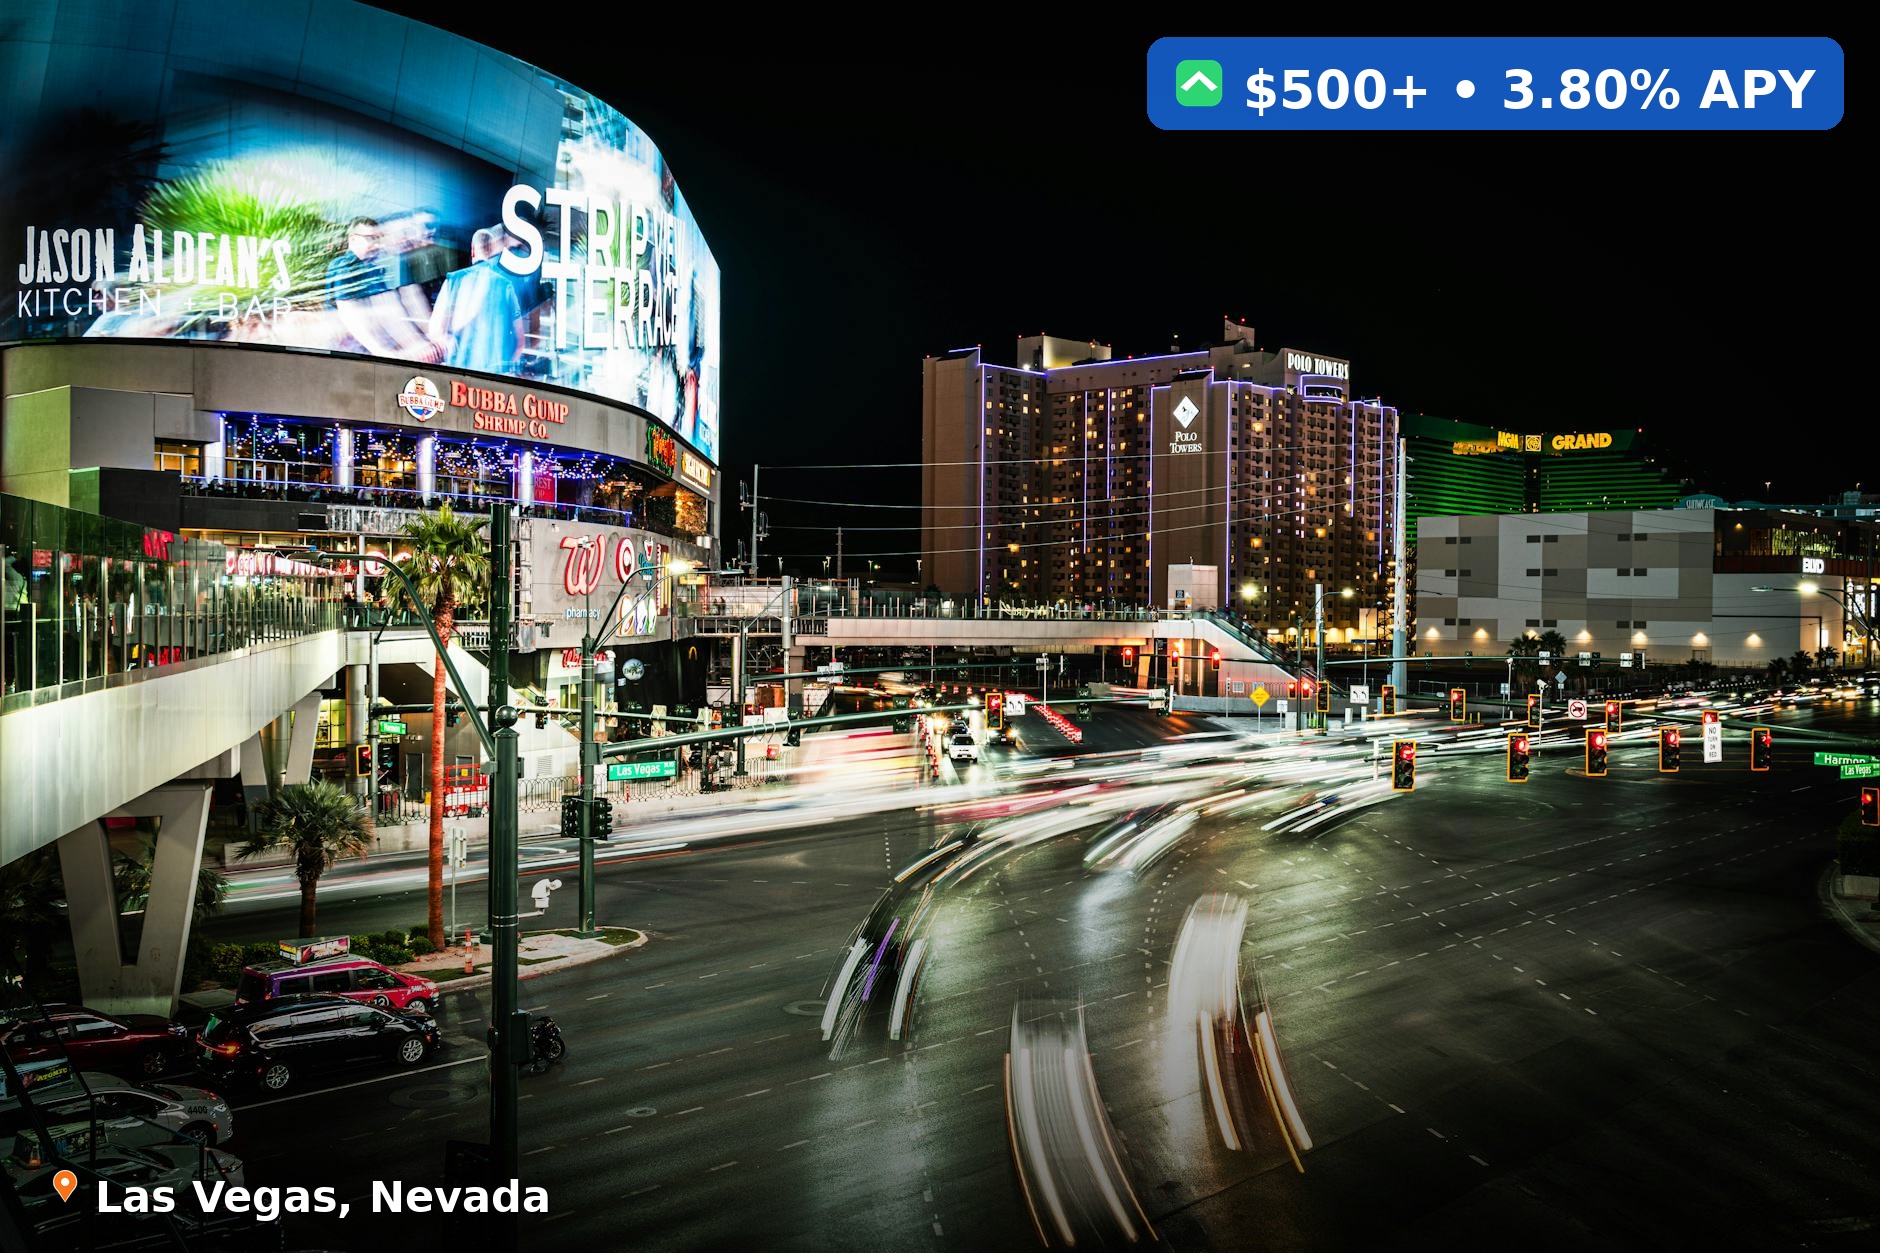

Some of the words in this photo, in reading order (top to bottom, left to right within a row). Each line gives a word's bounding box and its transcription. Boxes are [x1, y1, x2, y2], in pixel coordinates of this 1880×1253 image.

[500, 184, 649, 275] STRIP
[19, 225, 115, 285] JASON
[129, 223, 292, 292] ALDEAN'S
[18, 287, 161, 318] KITCHEN
[541, 263, 677, 350] TERRACE
[1287, 352, 1312, 373] POLO
[1314, 358, 1349, 380] TOWERS
[450, 380, 518, 416] BUBBA
[523, 393, 569, 424] GUMP
[474, 411, 527, 436] SHRIMP
[529, 420, 550, 439] CO.
[1175, 431, 1198, 442] POLO
[1170, 442, 1203, 454] TOWERS
[1498, 431, 1519, 450] MGM
[1551, 432, 1613, 450] GRAND
[1708, 727, 1717, 735] NO
[616, 765, 632, 776] Las
[634, 763, 661, 777] Vegas
[1824, 754, 1866, 765] Harmon
[1845, 764, 1855, 776] Las
[1855, 764, 1872, 777] Vegas
